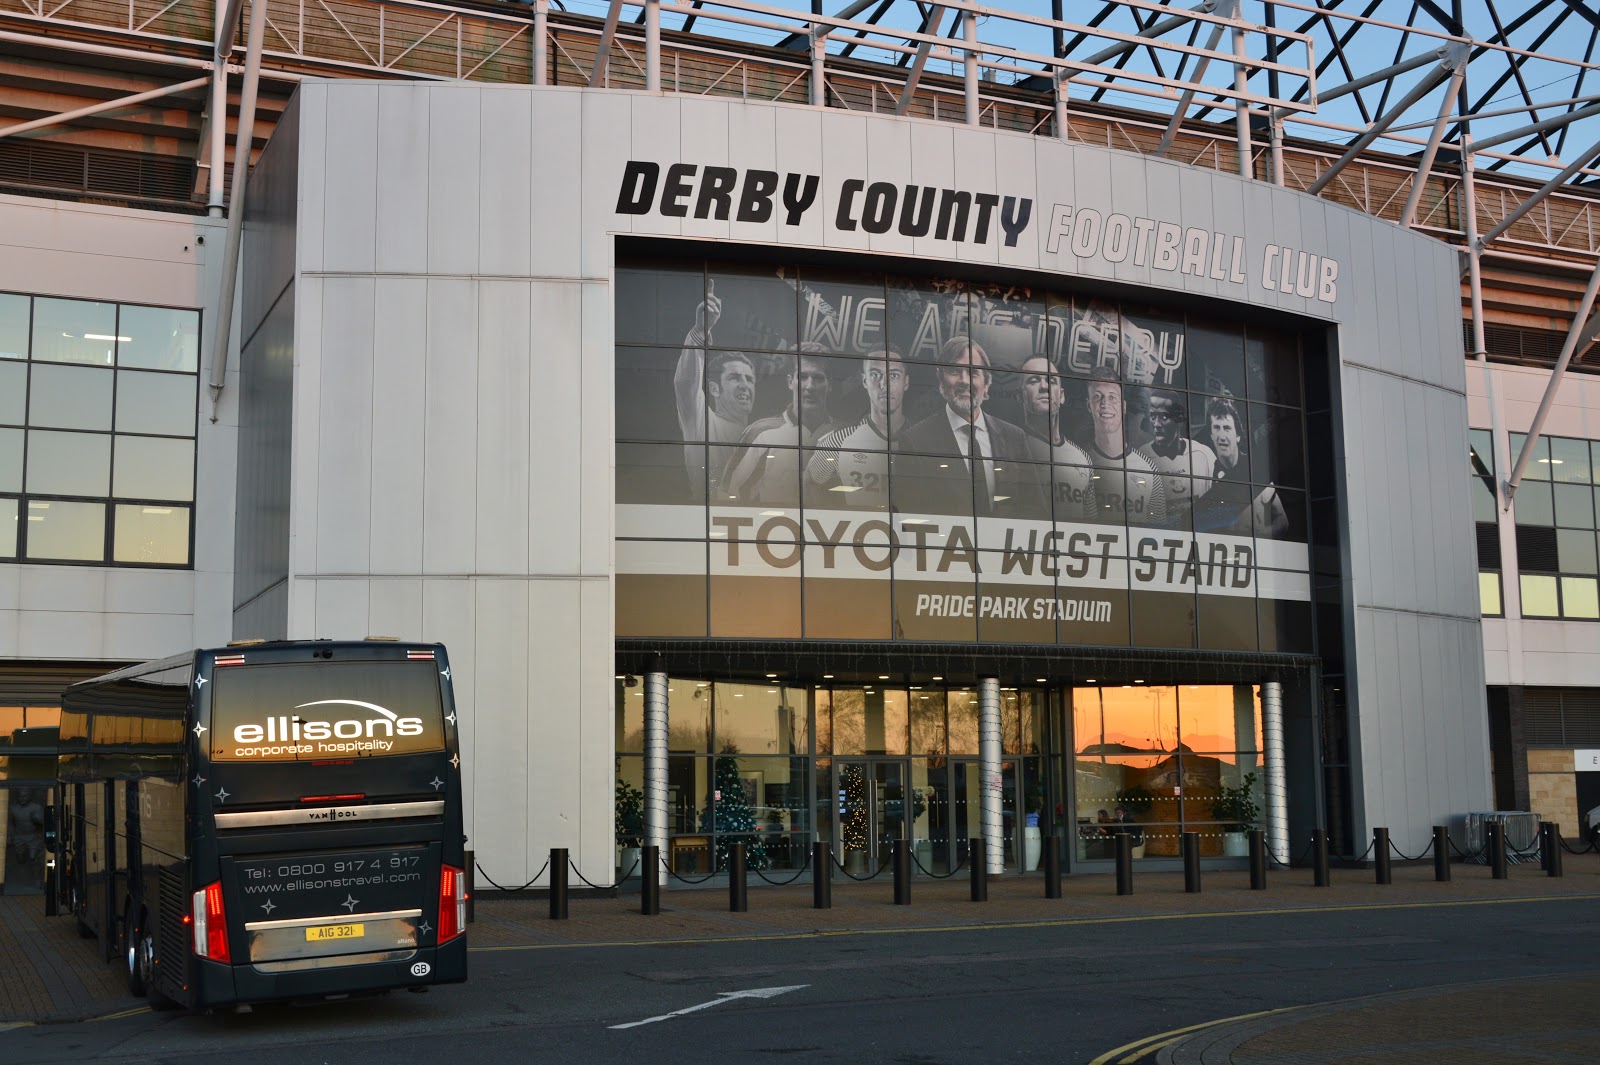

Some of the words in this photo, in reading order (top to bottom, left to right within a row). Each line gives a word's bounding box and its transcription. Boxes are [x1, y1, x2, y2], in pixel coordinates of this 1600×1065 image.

[615, 161, 820, 226] DERBY
[835, 178, 1033, 247] COUNTY
[1046, 203, 1246, 284] FOOTBALL
[1261, 244, 1339, 303] CLUB
[803, 292, 886, 352] WE
[1035, 314, 1185, 385] DERBY
[849, 470, 880, 493] 32
[712, 516, 983, 574] TOYOTA
[1001, 528, 1119, 580] WEST
[1135, 537, 1252, 589] STAND
[916, 594, 976, 617] PRIDE
[979, 596, 1030, 619] PARK
[1032, 598, 1112, 623] STADIUM
[233, 715, 424, 744] ellisons
[235, 742, 314, 758] corporate
[318, 739, 394, 753] hospitality
[244, 868, 272, 880] Tel:
[278, 863, 326, 878] 0800
[390, 856, 420, 868] 917
[244, 872, 421, 895] www.ellisonstravel.com
[413, 964, 427, 975] GB
